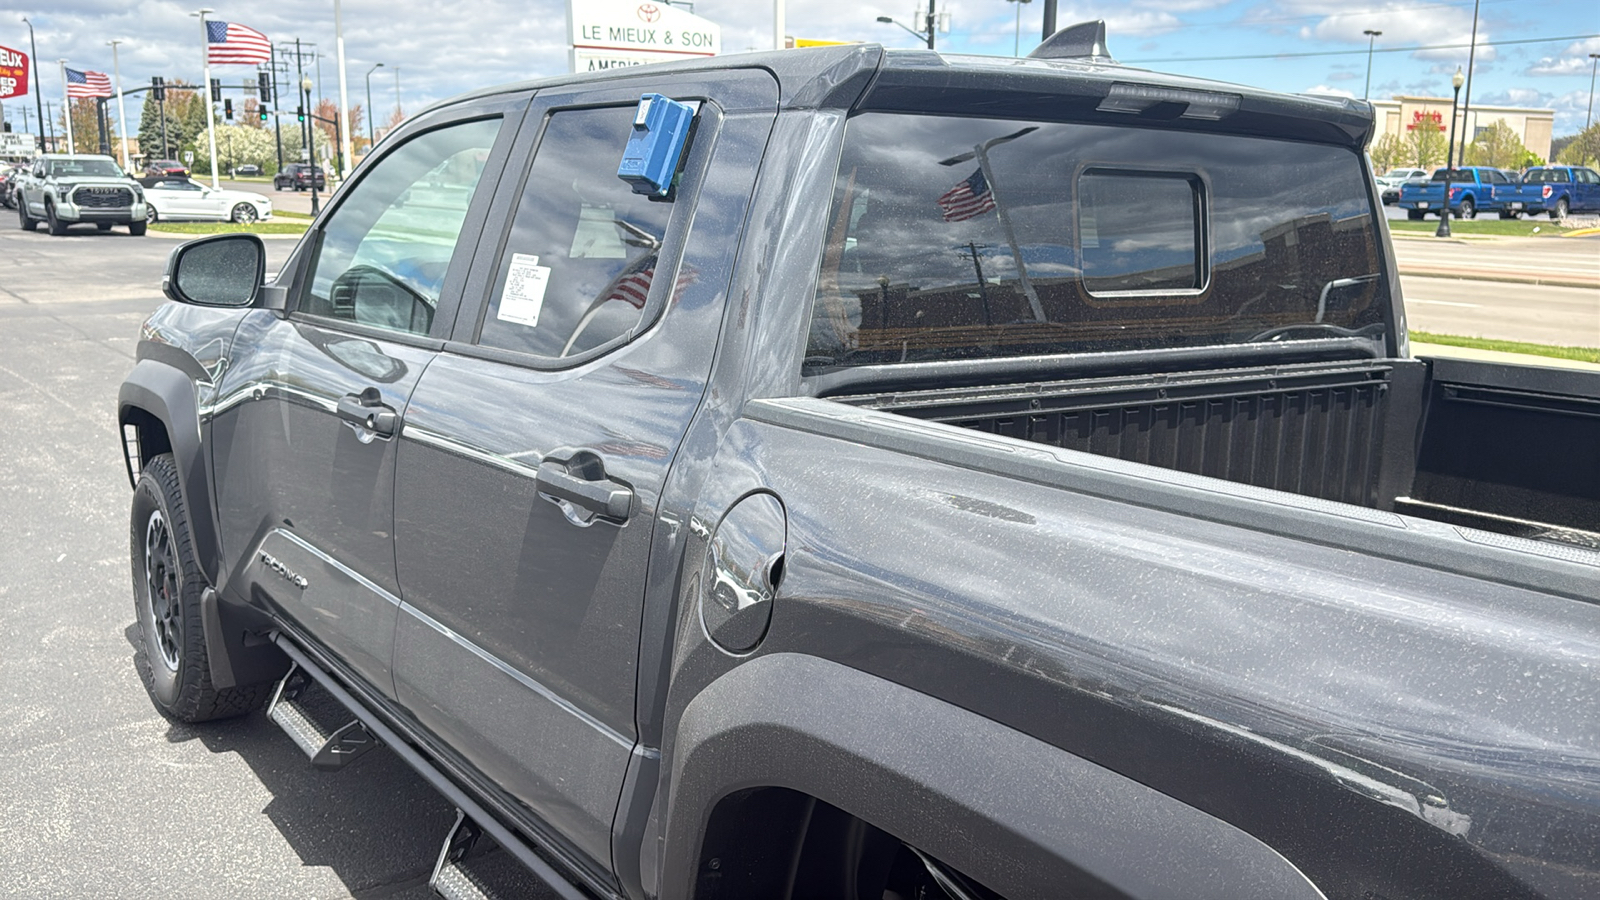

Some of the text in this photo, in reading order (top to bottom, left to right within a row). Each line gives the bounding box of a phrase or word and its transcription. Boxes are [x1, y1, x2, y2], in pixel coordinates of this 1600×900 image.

[582, 24, 713, 47] LE MIEUX & SON
